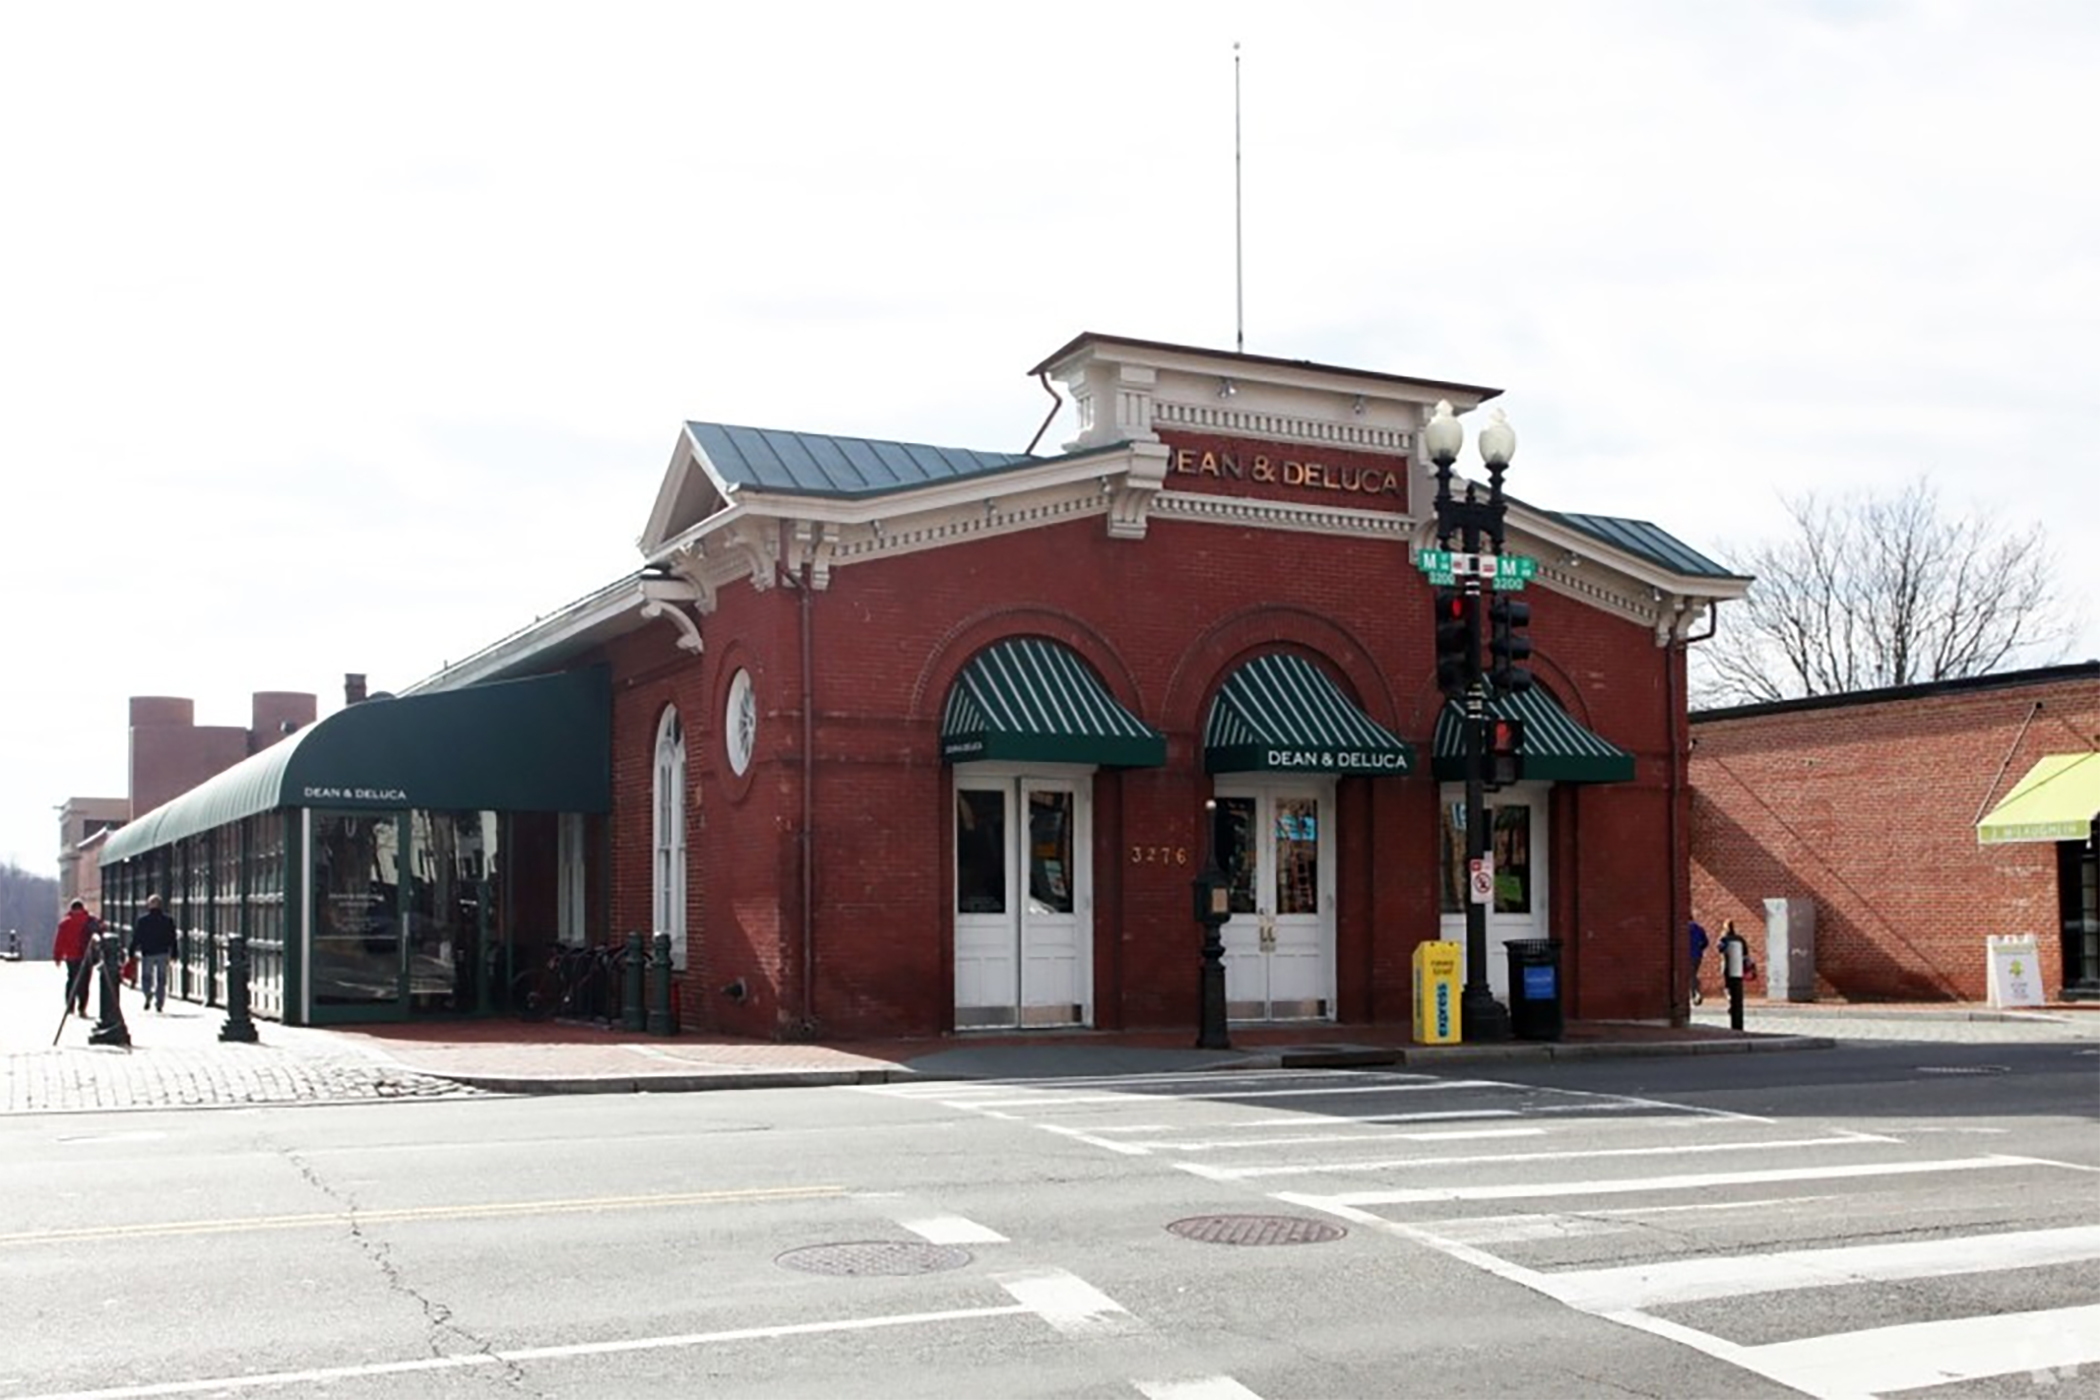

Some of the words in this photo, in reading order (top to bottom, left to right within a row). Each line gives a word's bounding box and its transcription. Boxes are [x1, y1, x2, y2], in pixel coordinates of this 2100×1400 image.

[1252, 455, 1275, 482] &
[1283, 460, 1398, 493] DELUCA
[1422, 552, 1437, 569] M
[1501, 559, 1517, 576] M
[1268, 750, 1317, 765] DEAN
[1321, 752, 1334, 766] &
[1338, 752, 1407, 768] DELUCA
[304, 786, 340, 798] DEAN
[343, 788, 352, 798] &
[355, 788, 406, 800] DELUCA
[1131, 846, 1187, 865] 3276
